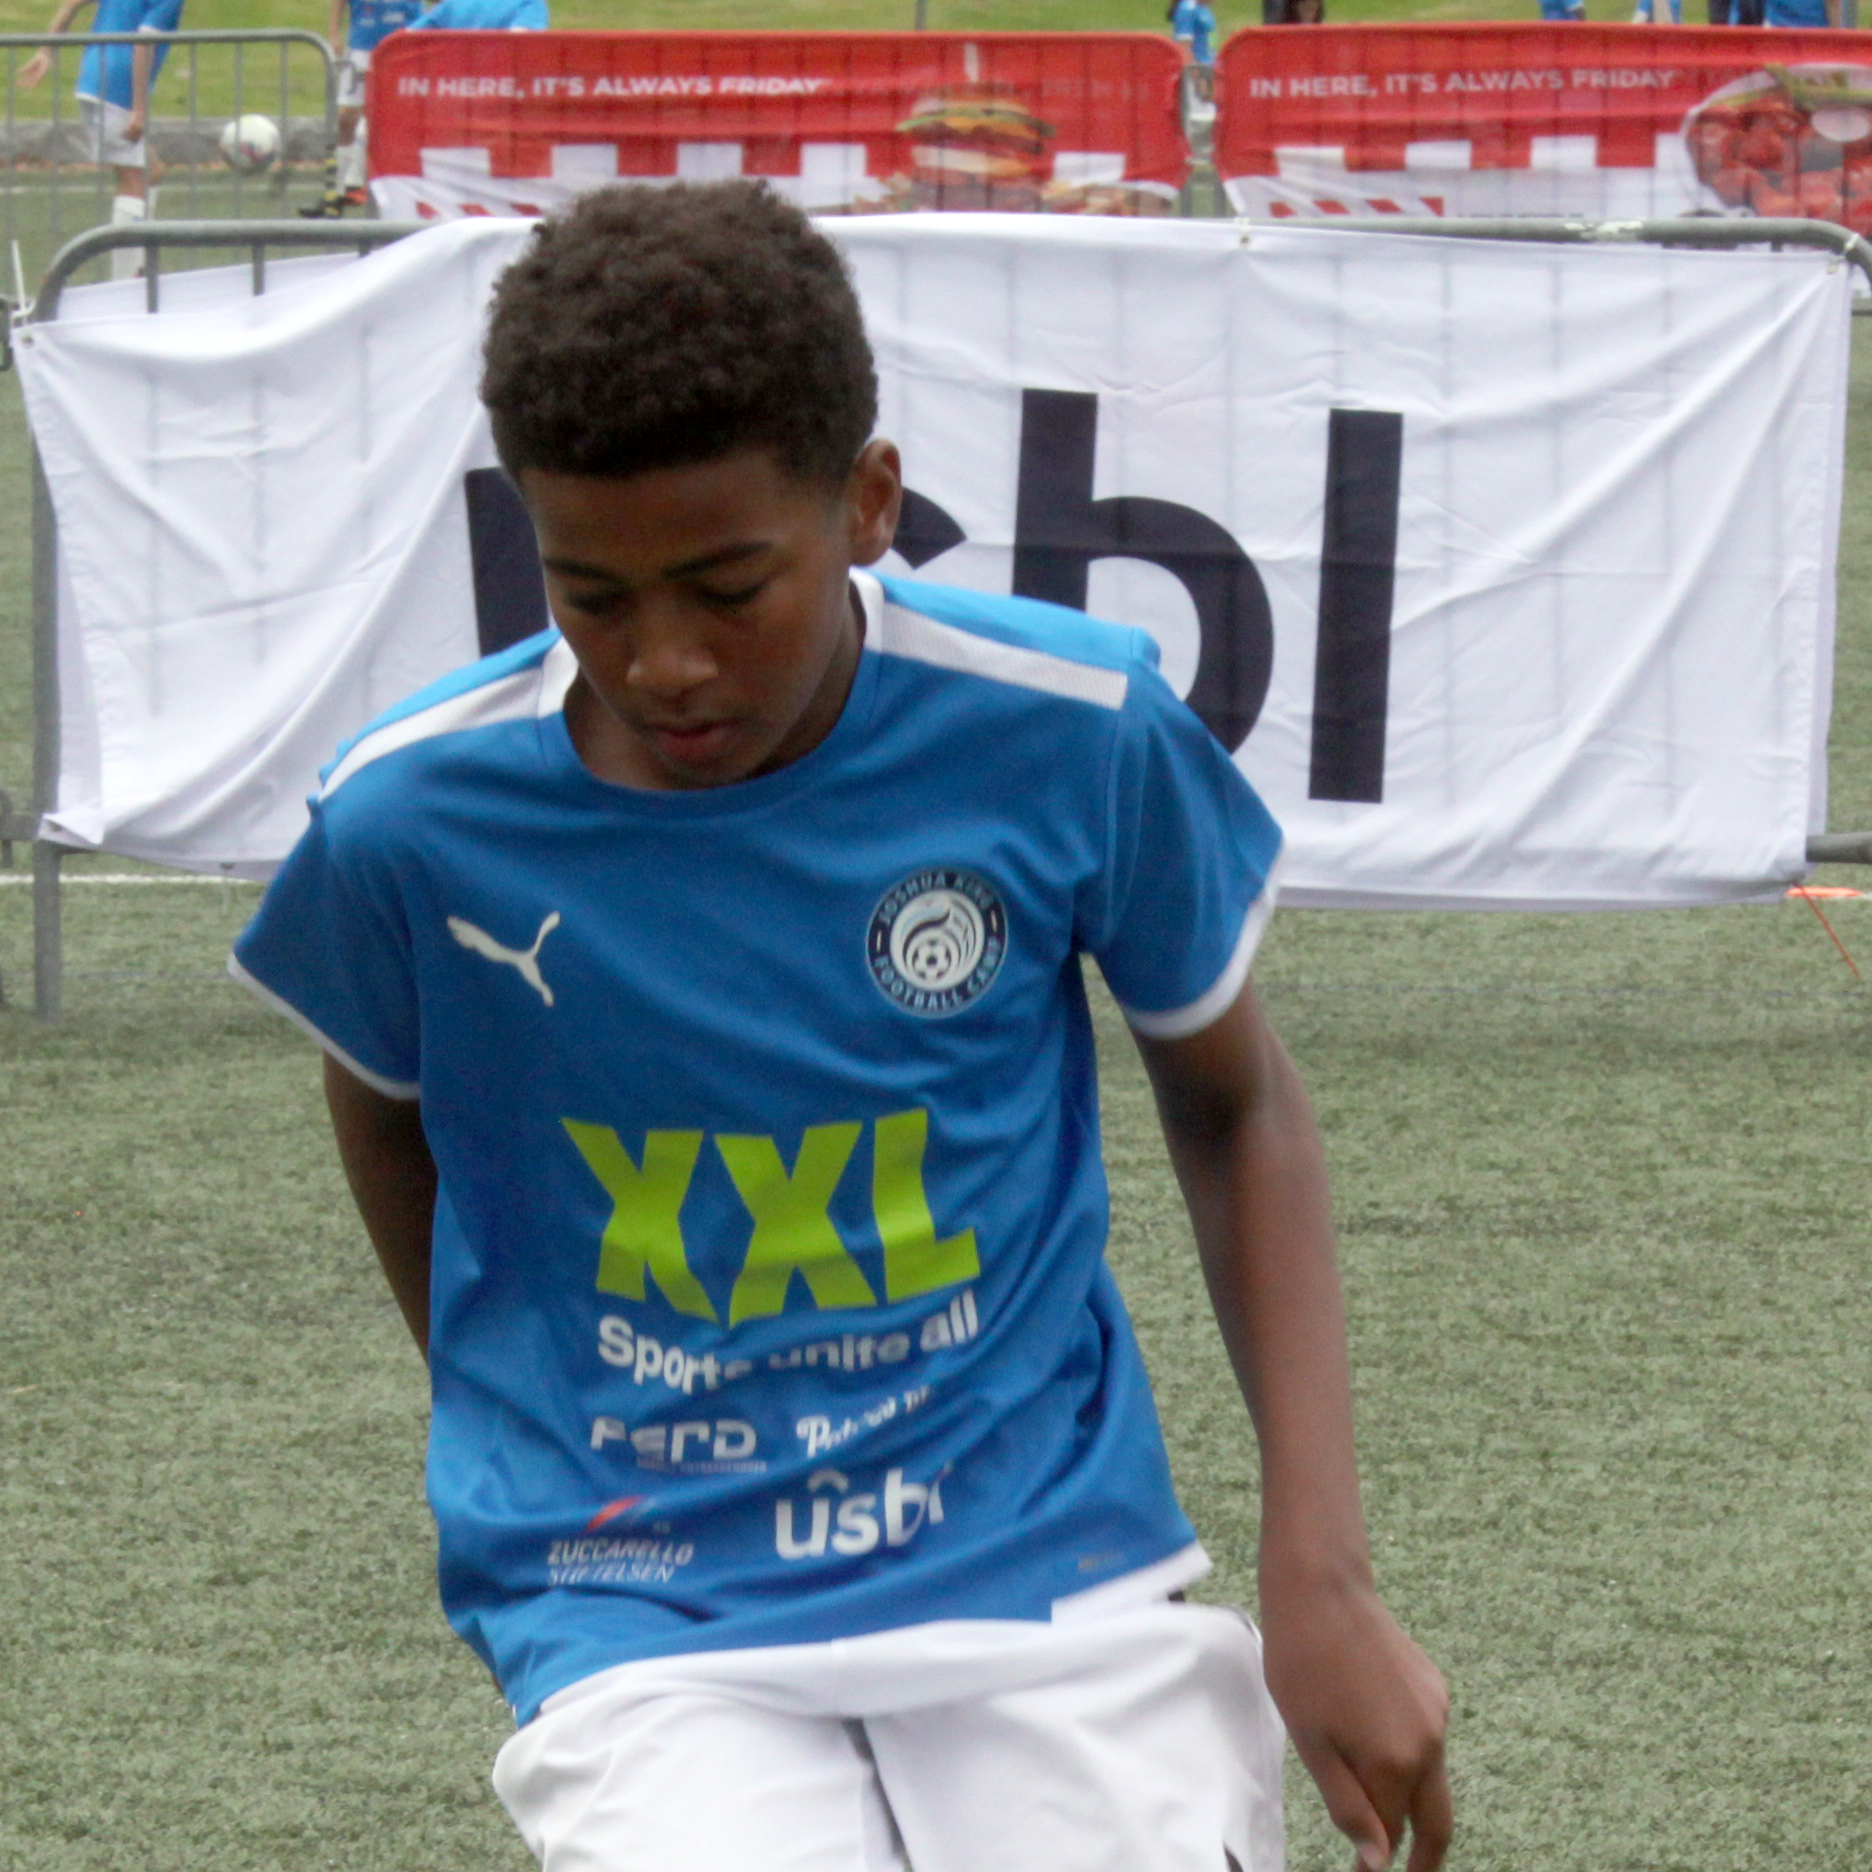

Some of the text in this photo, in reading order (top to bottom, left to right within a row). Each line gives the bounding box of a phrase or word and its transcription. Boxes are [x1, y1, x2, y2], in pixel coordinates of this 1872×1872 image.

[397, 76, 823, 99] IN HERE, IT'S ALWAYS FRIDAY
[1250, 68, 1675, 99] IN HERE, IT'S ALWAYS FRIDAY
[874, 954, 963, 1012] FOOTBALL
[560, 1107, 981, 1330] XXL
[919, 1288, 979, 1352] all
